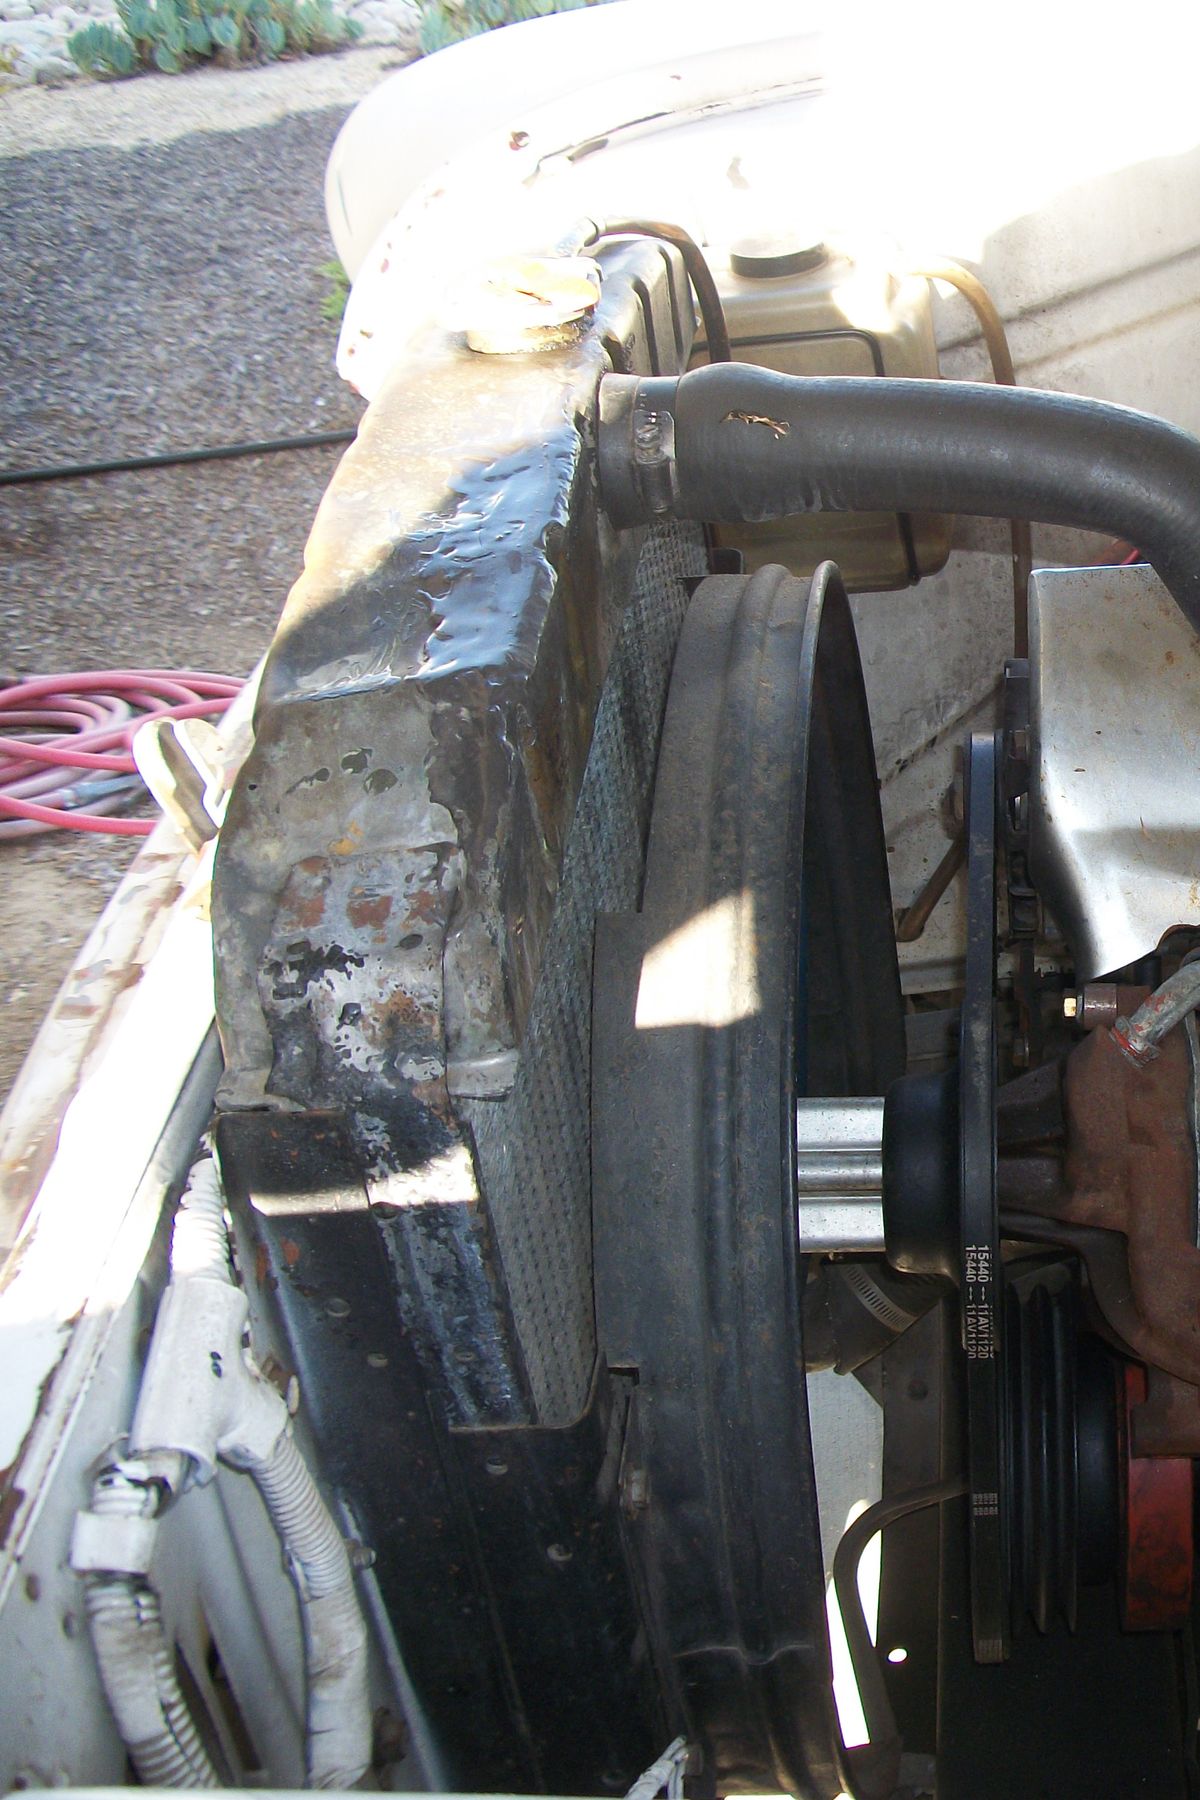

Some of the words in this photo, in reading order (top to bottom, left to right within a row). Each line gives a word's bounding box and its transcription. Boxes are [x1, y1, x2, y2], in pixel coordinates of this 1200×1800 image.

[965, 1245, 977, 1283] 15440
[977, 1245, 990, 1283] 15440
[977, 1303, 990, 1359] 11AV1120
